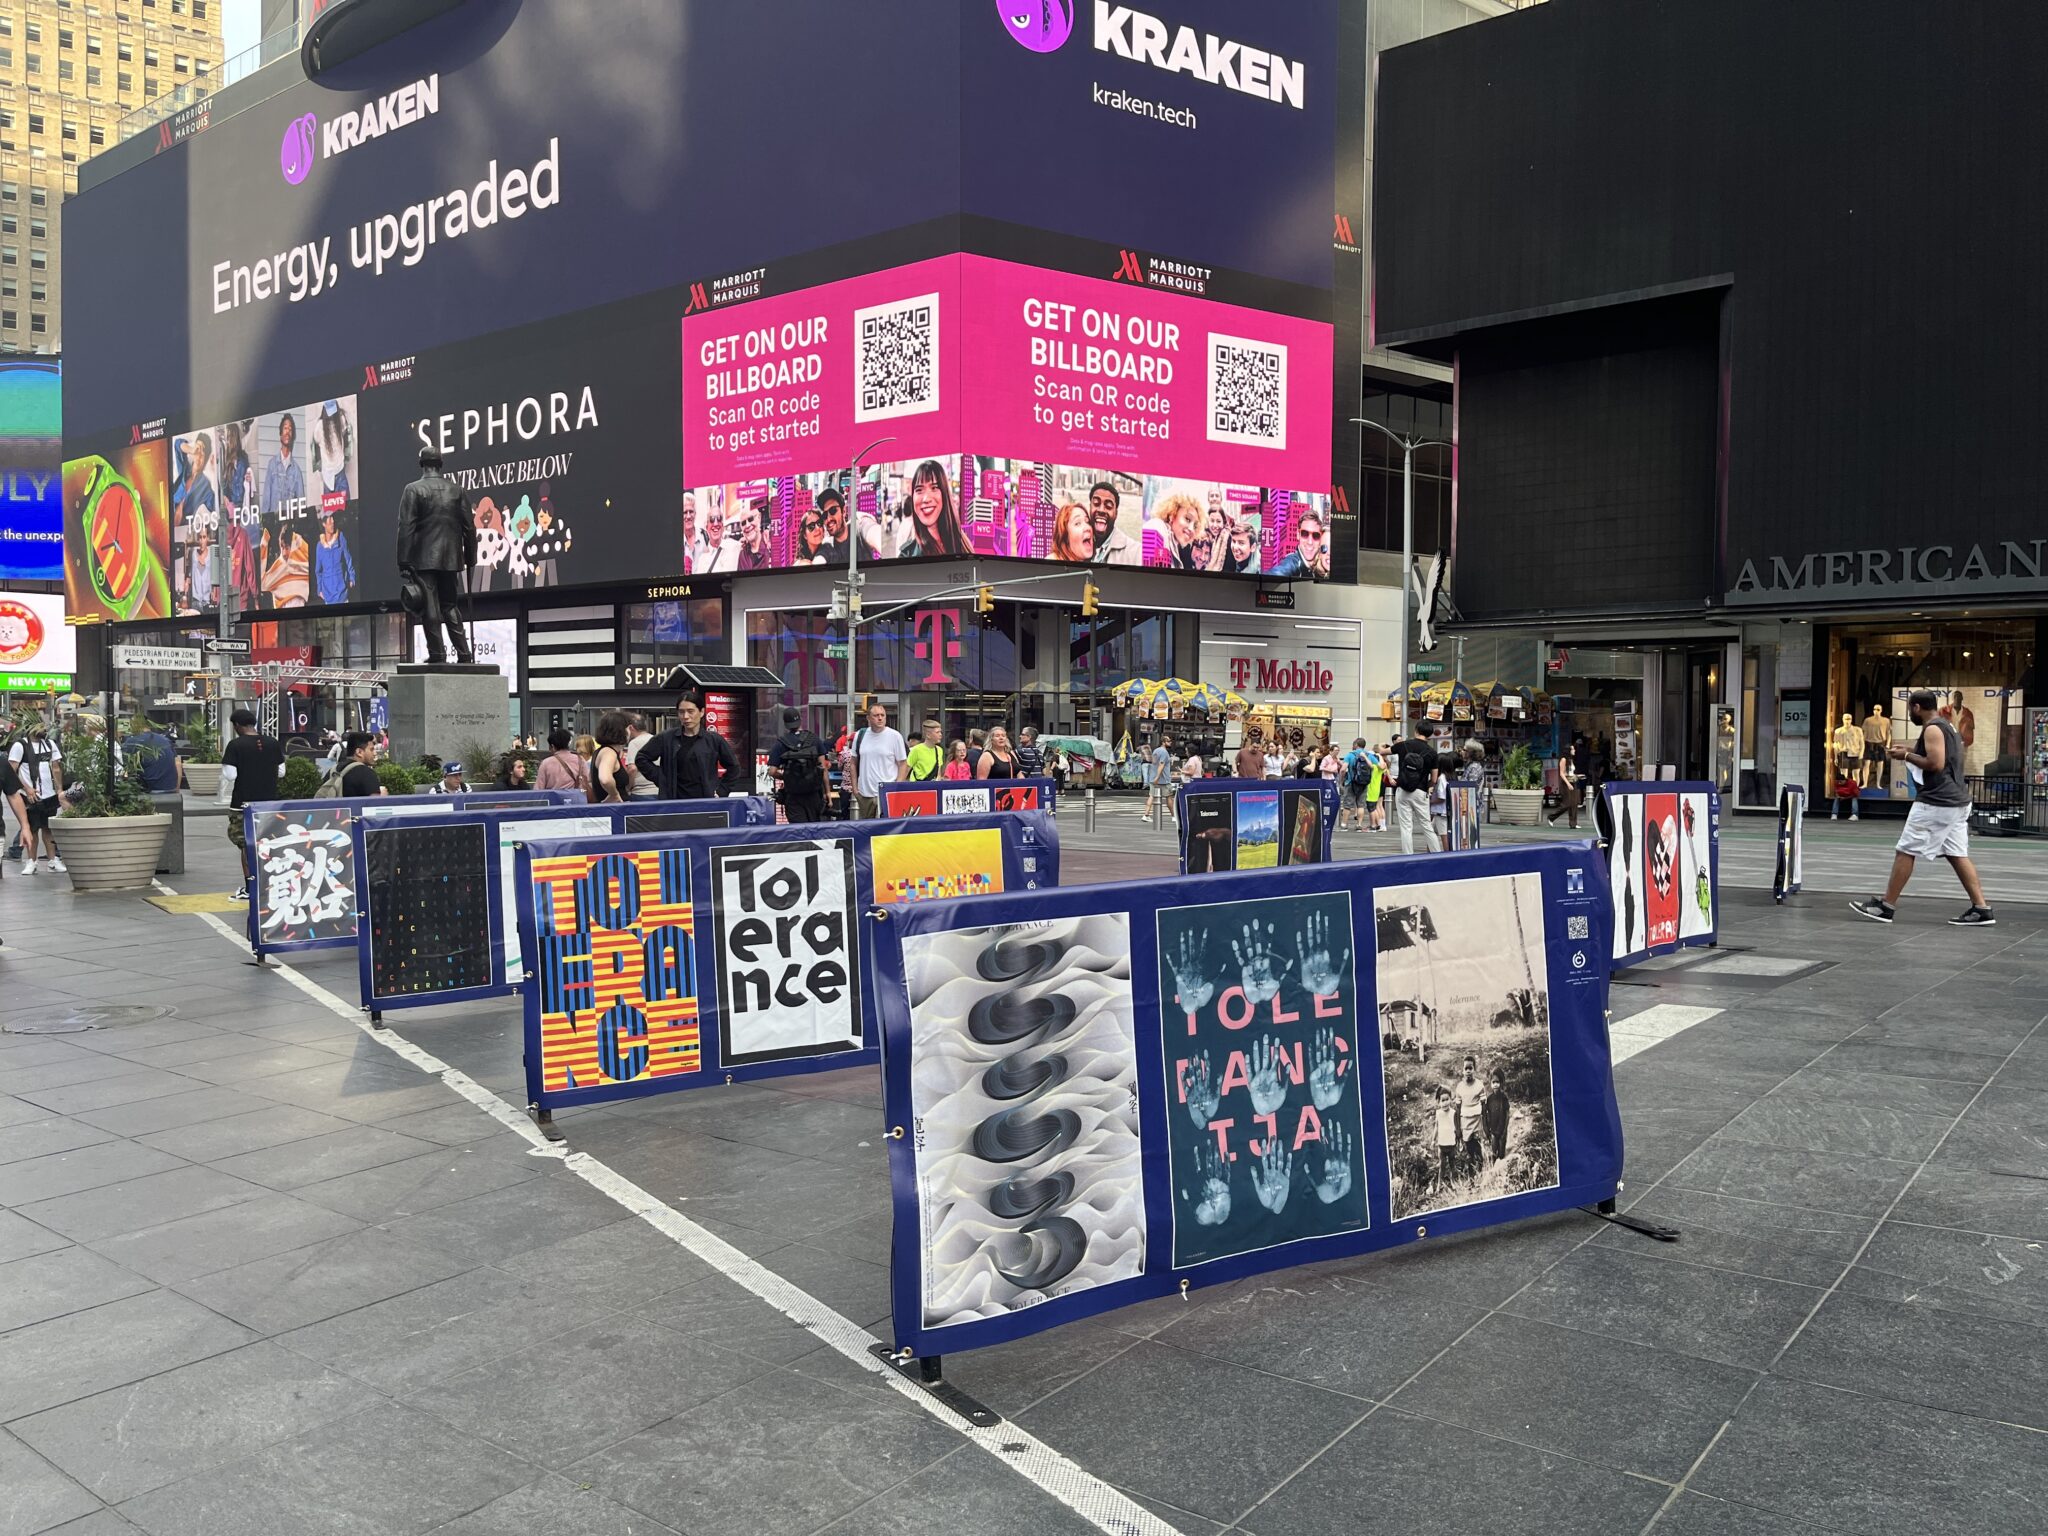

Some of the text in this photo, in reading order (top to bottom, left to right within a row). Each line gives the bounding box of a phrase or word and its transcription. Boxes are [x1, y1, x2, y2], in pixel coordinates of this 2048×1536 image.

[1095, 1, 1305, 110] KRAKEN
[175, 98, 213, 127] MARRIOTT
[322, 74, 440, 159] KRAKEN
[1093, 82, 1197, 130] kraken.tech
[175, 115, 209, 141] MARQUIS
[212, 137, 561, 314] Energy, upgraded
[1333, 242, 1362, 254] MARRIOTT
[713, 267, 766, 290] MARRIOTT
[1149, 257, 1212, 280] MARRIOTT
[1149, 272, 1206, 293] MARQUIS
[713, 283, 760, 303] MARQUIS
[1023, 297, 1180, 352] GET ON OUR
[700, 315, 829, 367] GET ON OUR
[380, 356, 416, 372] MARRIOTT
[1030, 336, 1174, 386] BILLBOARD
[380, 369, 412, 383] MARQUIS
[706, 353, 823, 401] BILLBOARD
[708, 390, 820, 427] Scan QR code
[1033, 375, 1171, 414] Scan QR code
[142, 417, 167, 431] MARRIOTT
[142, 428, 165, 440] MARQUIS
[417, 385, 600, 458] SEPHORA
[708, 413, 820, 452] to get started
[1034, 401, 1170, 440] to get started
[517, 452, 573, 483] BELOW
[0, 472, 51, 502] LY
[861, 483, 874, 492] NYC
[1229, 491, 1241, 500] TIMES
[185, 497, 308, 535] TOPS FOR LIFE
[976, 524, 991, 534] NYC
[4, 527, 23, 540] the
[947, 572, 970, 584] 1535
[1734, 539, 2048, 592] AMERICAN
[647, 585, 691, 598] SEPHORA
[124, 649, 162, 657] PEDESTRIAN
[8, 676, 72, 688] NEW YORK
[1256, 658, 1334, 692] Mobile
[1416, 663, 1442, 673] Broadway
[1984, 689, 2018, 698] DAY
[724, 854, 820, 913] Tol
[729, 911, 844, 964] era
[731, 960, 848, 1014] nce
